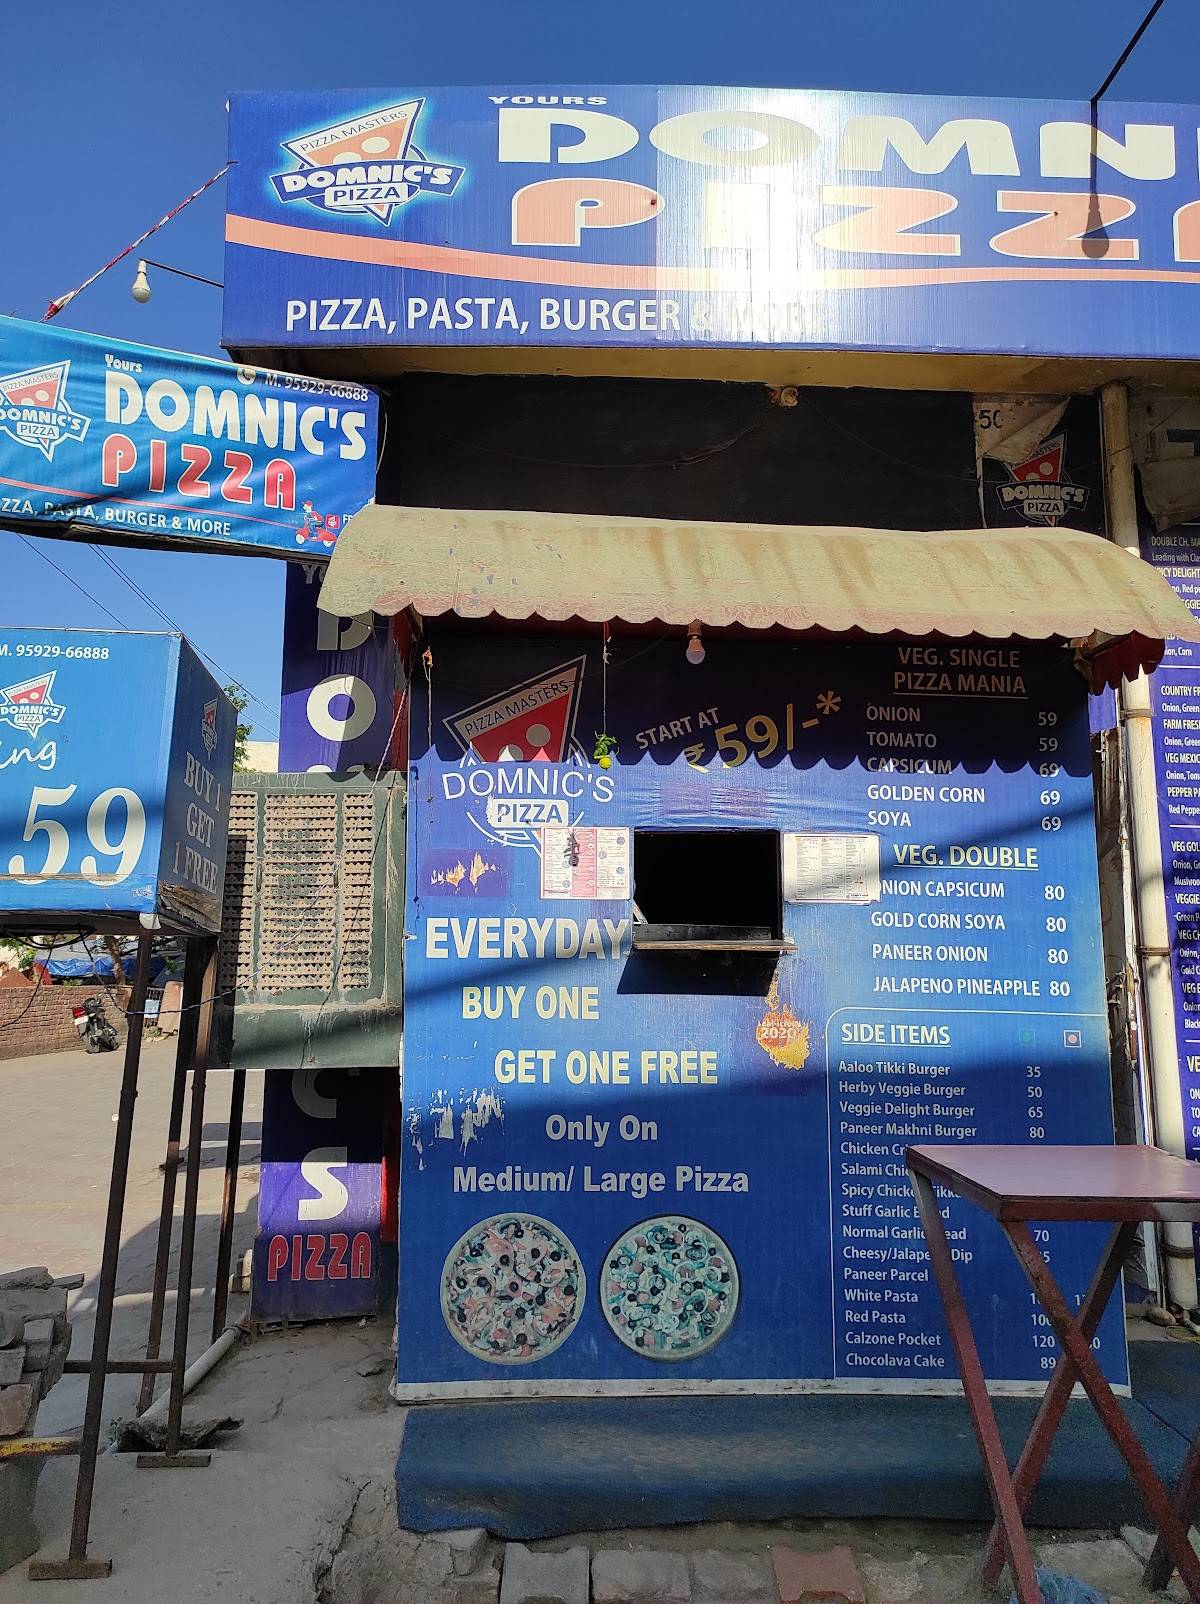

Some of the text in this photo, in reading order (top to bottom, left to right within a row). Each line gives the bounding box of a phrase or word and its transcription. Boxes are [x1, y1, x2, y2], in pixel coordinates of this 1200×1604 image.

[488, 96, 608, 106] YOURS
[300, 109, 408, 152] PIZZA MASTERS
[498, 107, 1200, 181] DOMN
[282, 163, 453, 193] DOMNIC'S
[332, 186, 401, 202] PIZZA
[511, 177, 1200, 263] PIZZ
[285, 298, 397, 335] PIZZA,
[406, 297, 529, 335] PASTA,
[541, 298, 682, 332] BURGER
[104, 353, 143, 374] Yours
[25, 371, 59, 385] MASTERS
[264, 372, 369, 402] M. 95929-66888
[104, 370, 367, 461] DOMNIC'S
[20, 424, 56, 437] PIZZA
[102, 433, 297, 511] PIZZA
[1001, 485, 1085, 502] DOMNIC'S
[1027, 502, 1061, 512] PIZZA
[44, 501, 100, 522] PASTA,
[105, 507, 167, 528] BURGER
[171, 516, 182, 530] &
[187, 517, 231, 536] MORE
[16, 643, 110, 660] 95929-66888
[897, 647, 1021, 669] VEG. SINGLE
[894, 671, 1027, 694] PIZZA MANIA
[1161, 685, 1192, 697] COUNTRY
[463, 679, 571, 737] PIZZA MASTERS
[866, 704, 1058, 726] ONION 59
[636, 706, 721, 750] START AT
[1163, 718, 1182, 730] FARM
[866, 731, 1059, 752] TOMATO 59
[866, 756, 1060, 778] CAPSICUM 69
[1165, 752, 1179, 764] VEG
[183, 751, 215, 806] BUY
[441, 767, 616, 804] DOMNIC'S
[867, 784, 1061, 806] GOLDEN CORN 69
[1167, 786, 1193, 798] PEPPER
[496, 803, 564, 824] PIZZA
[867, 810, 1063, 832] SOYA 69
[8, 783, 147, 887] 59
[186, 802, 215, 849] GET
[893, 844, 1039, 869] VEG. DOUBLE
[1171, 841, 1186, 852] VEG
[183, 845, 219, 896] FREE
[880, 879, 1066, 902] NION CAPSICUM 80
[870, 911, 1067, 933] GOLD CORN SOYA 80
[425, 916, 631, 960] EVERYDAY
[872, 943, 1070, 965] PANEER ONION 80
[872, 976, 1071, 998] JALAPENO PINEAPPLE 80
[461, 985, 600, 1020] BUY ONE
[840, 1022, 951, 1046] SIDE ITEMS
[493, 1050, 718, 1084] GET ONE FREE
[838, 1060, 1042, 1079] Aaloo Tikki Burger 35
[839, 1080, 1043, 1100] Herby Veggie Burger 50
[839, 1101, 1044, 1120] Veggie Delight Burger 65
[545, 1114, 658, 1148] Only On
[840, 1121, 1045, 1140] Paneer Makhni Burger 80
[840, 1141, 889, 1156] Chicken
[841, 1162, 883, 1176] Salami
[453, 1165, 750, 1198] Medium/ Large Pizza
[841, 1183, 875, 1199] Spicy
[842, 1204, 873, 1218] Stuff
[874, 1205, 911, 1218] Garlic
[842, 1225, 888, 1240] Normal
[1033, 1229, 1050, 1242] 70
[267, 1231, 372, 1281] PIZZA
[950, 1248, 974, 1264] Dip
[844, 1267, 929, 1282] Paneer Parcel
[844, 1288, 919, 1303] White Pasta
[845, 1310, 906, 1324] Red Pasta
[845, 1331, 1056, 1348] Calzone Pocket 120
[845, 1353, 1057, 1369] Chocolava Cake 89
